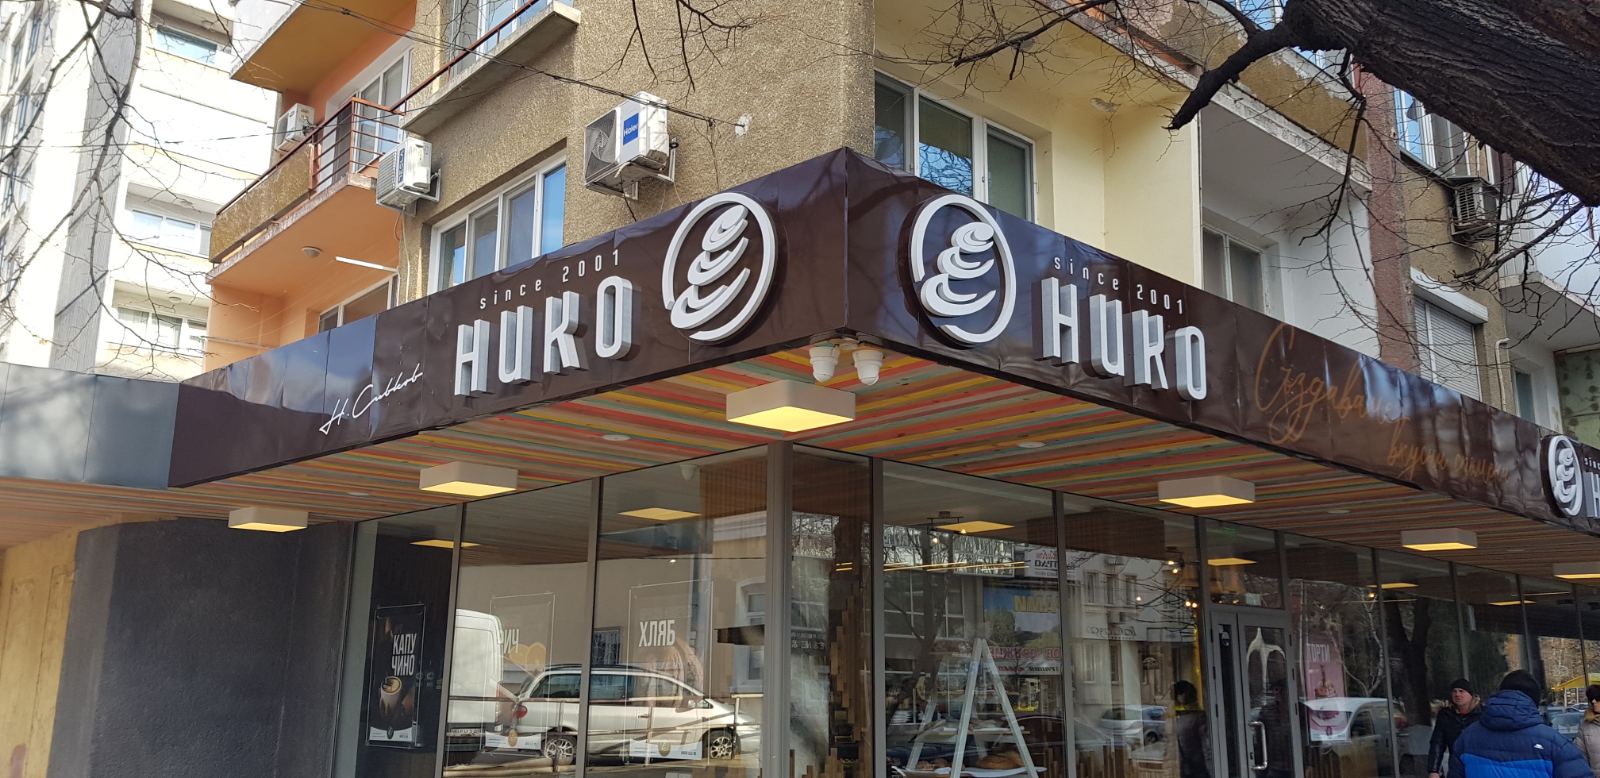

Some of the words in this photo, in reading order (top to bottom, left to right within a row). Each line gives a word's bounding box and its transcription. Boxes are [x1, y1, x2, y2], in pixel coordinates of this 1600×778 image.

[479, 277, 543, 309] since
[562, 249, 620, 282] 2001
[1054, 256, 1119, 291] since
[1136, 283, 1183, 315] 2001
[392, 633, 417, 655] КАПУ
[638, 619, 676, 647] ХЛЯБ
[391, 654, 415, 676] ЧИНО
